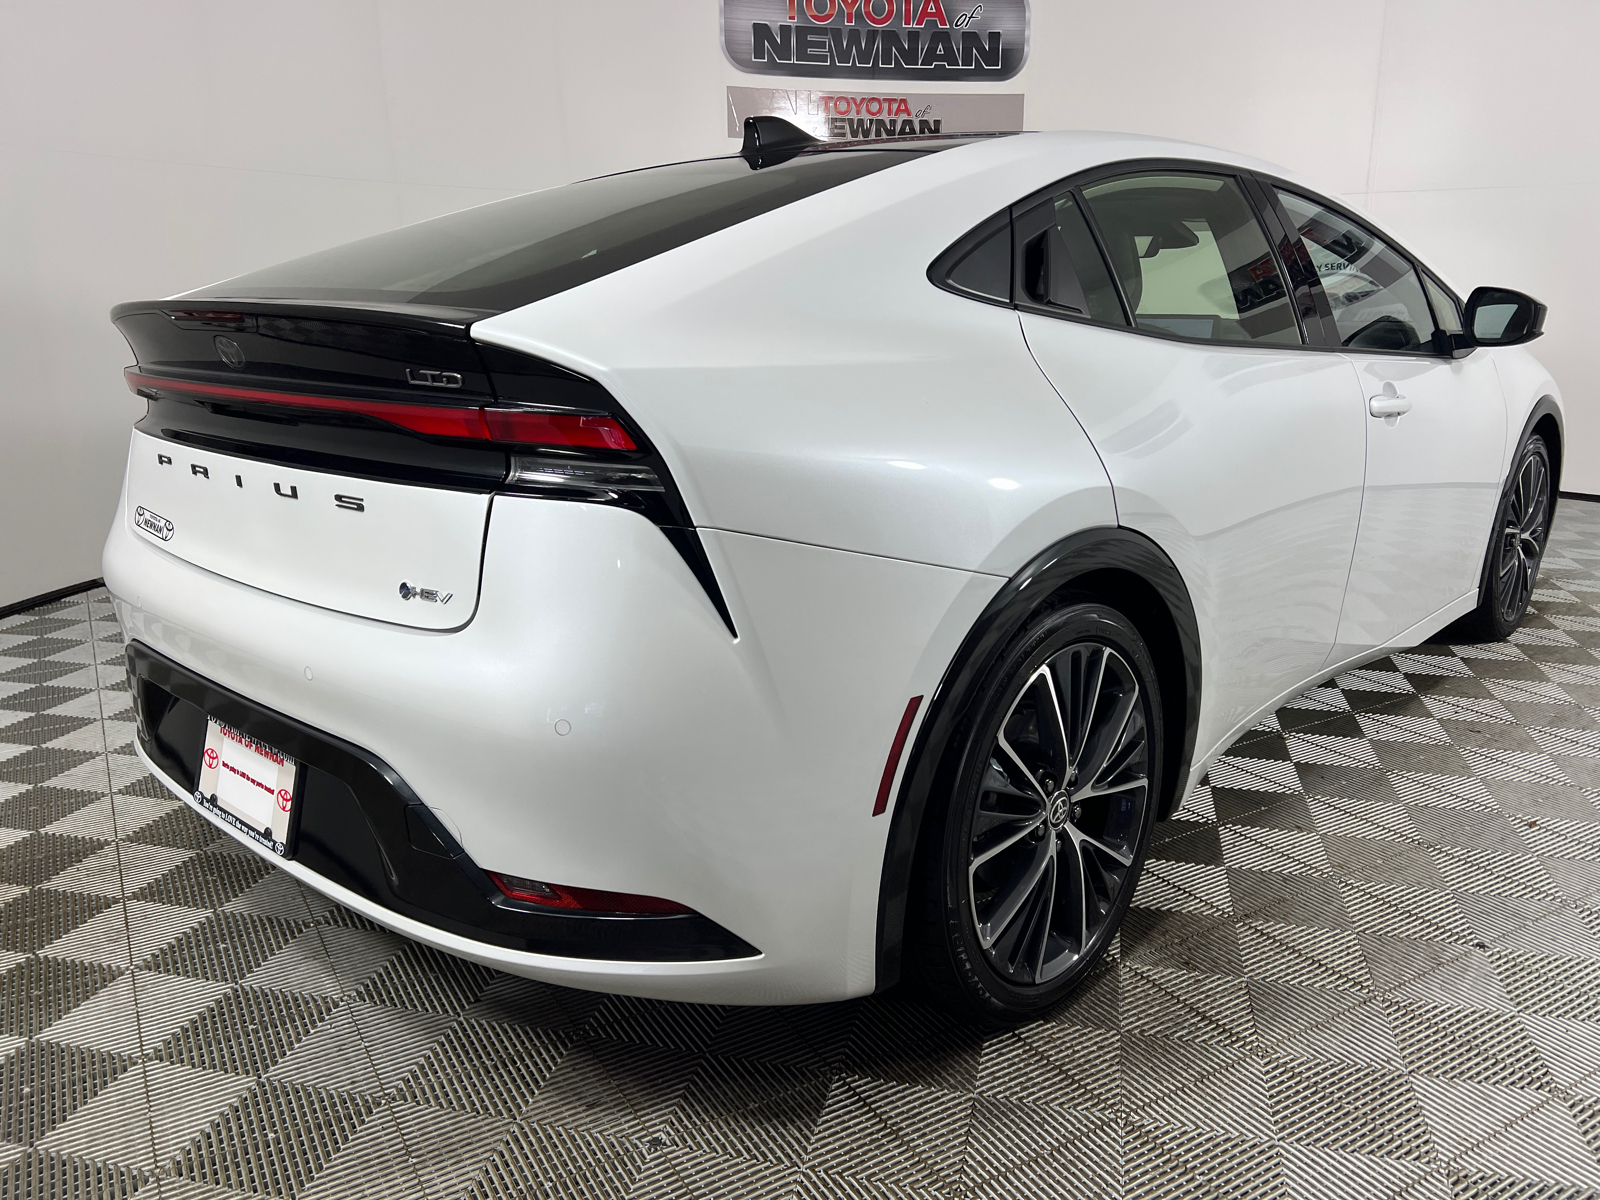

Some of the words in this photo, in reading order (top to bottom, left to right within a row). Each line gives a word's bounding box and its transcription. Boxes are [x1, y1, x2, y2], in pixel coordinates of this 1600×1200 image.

[954, 4, 983, 29] of
[752, 23, 1002, 69] NEWNAN
[819, 95, 912, 118] TOYOTA
[914, 104, 932, 119] of
[815, 117, 943, 139] EWNAN
[405, 368, 463, 389] LTD
[157, 453, 365, 512] PRIUS
[219, 726, 243, 745] TOYOTA
[244, 738, 254, 750] OF
[254, 744, 285, 767] NEWNAN
